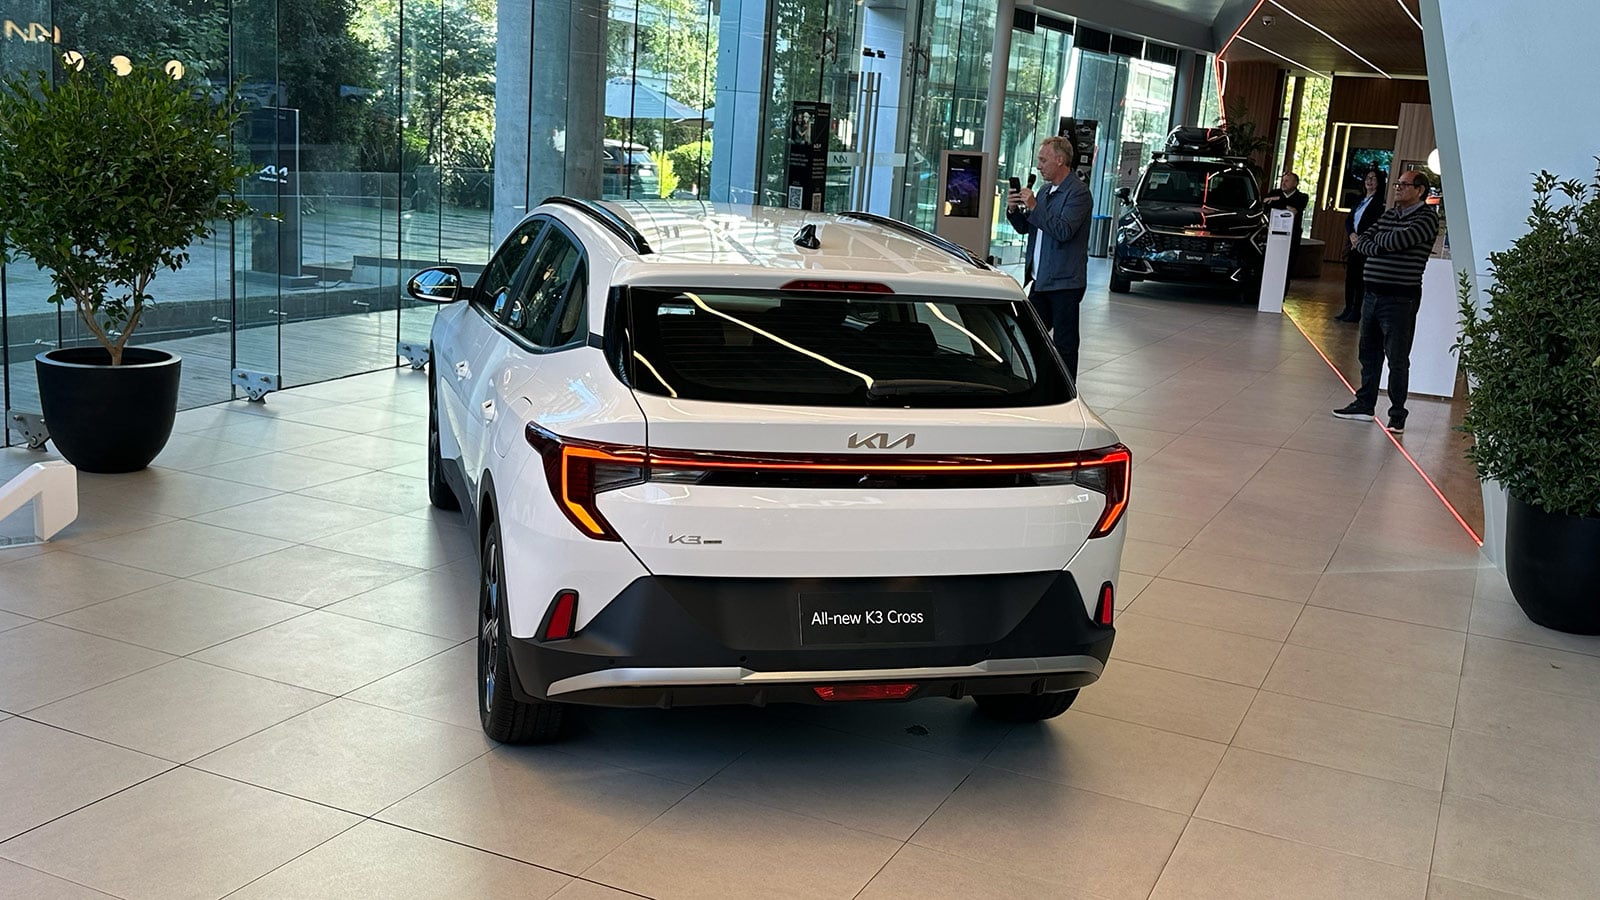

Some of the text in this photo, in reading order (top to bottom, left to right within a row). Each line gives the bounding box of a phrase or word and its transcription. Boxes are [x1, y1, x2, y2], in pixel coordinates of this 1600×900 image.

[847, 432, 915, 448] KIA
[669, 534, 701, 544] K3
[811, 610, 924, 625] All-new K3 Cross
